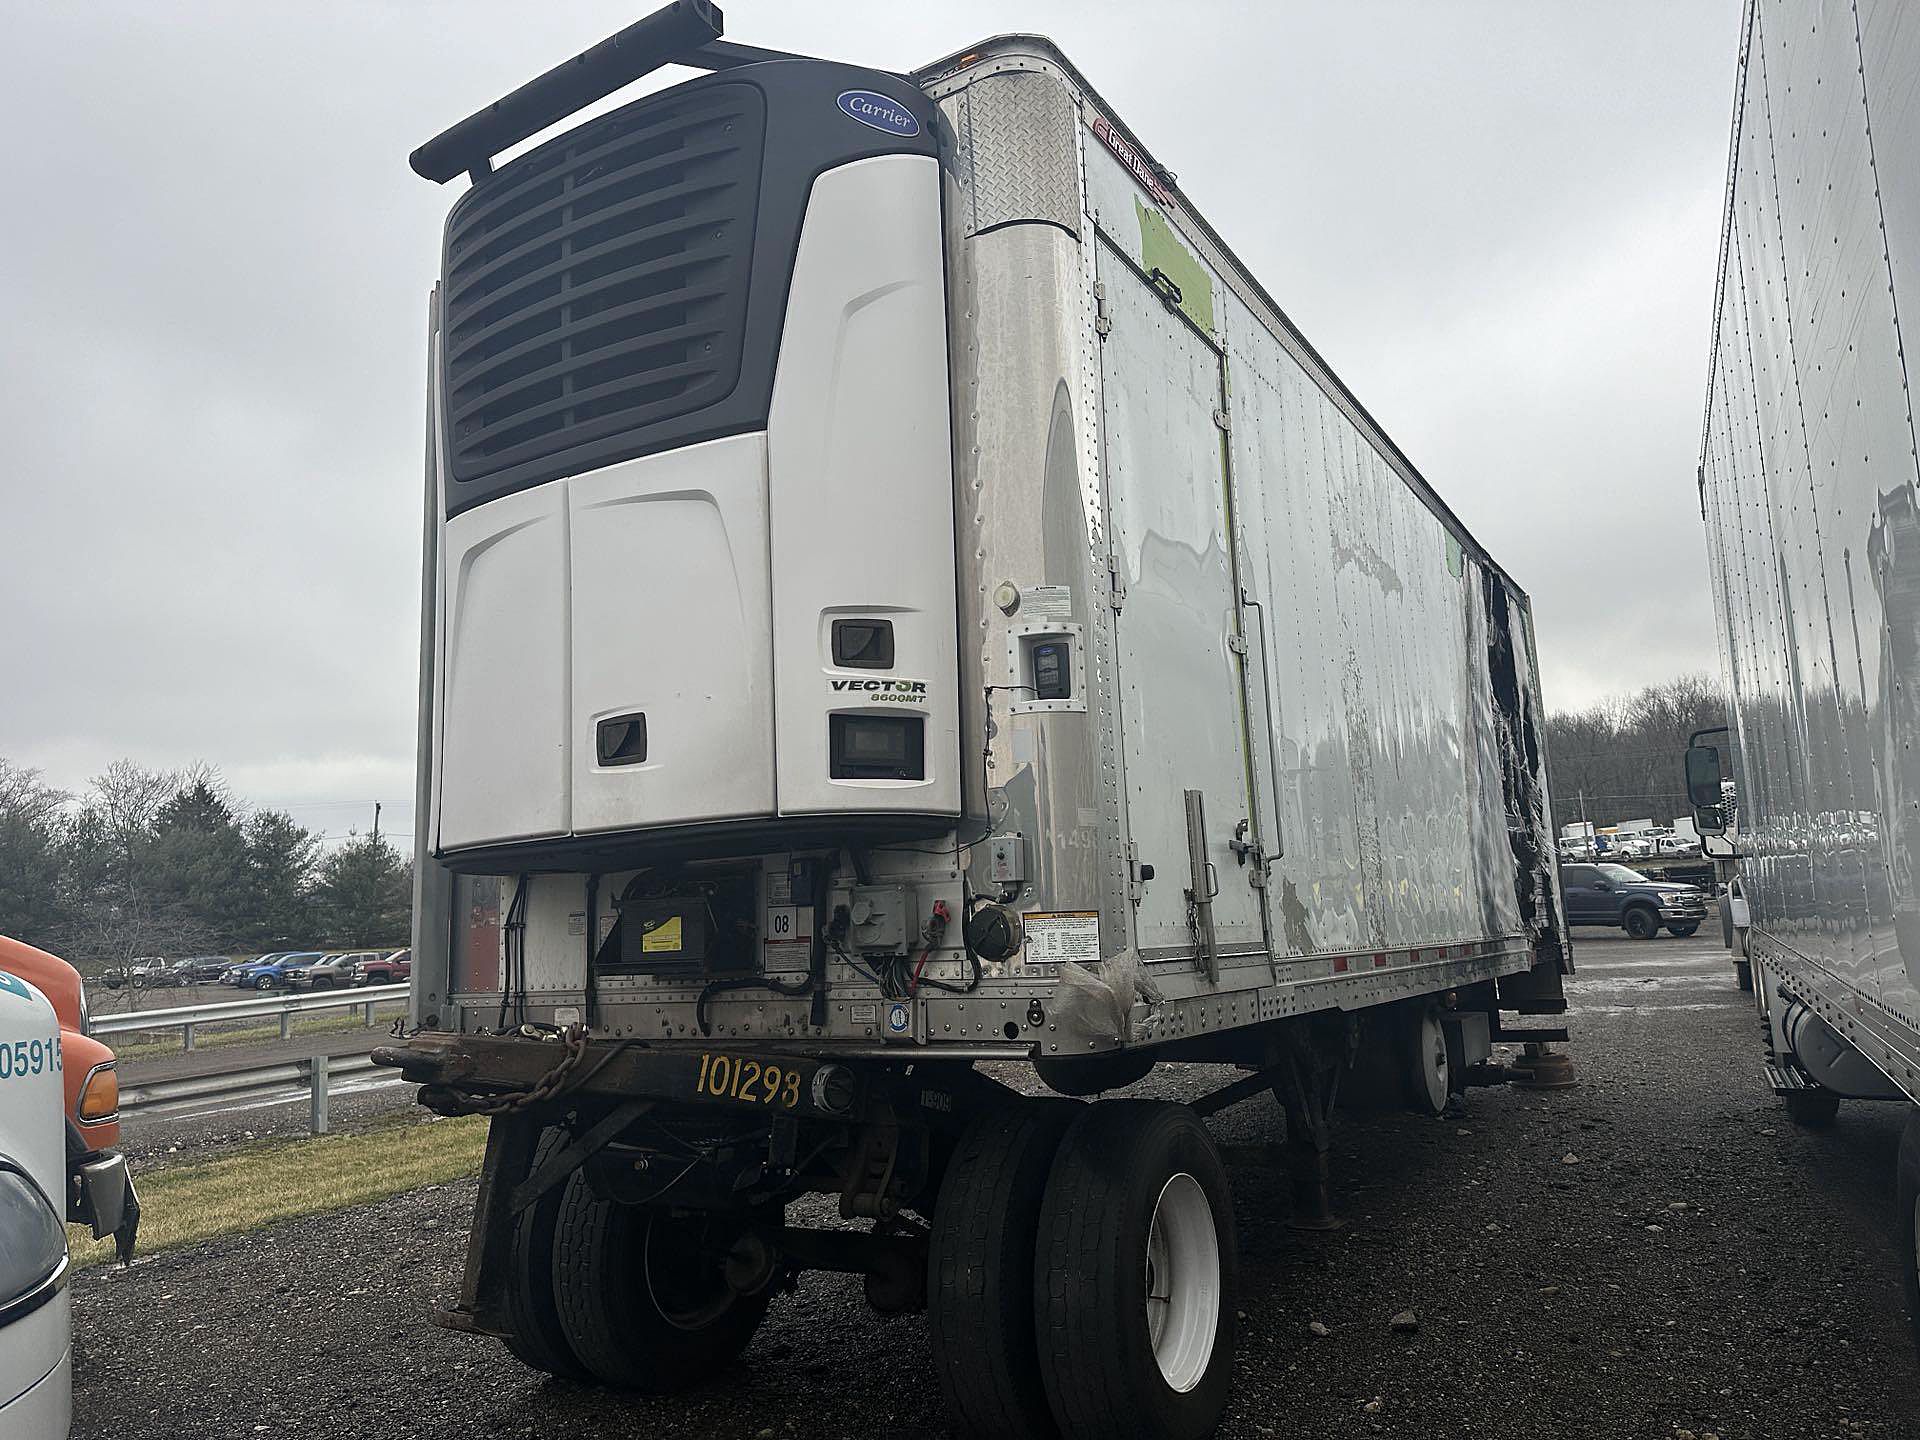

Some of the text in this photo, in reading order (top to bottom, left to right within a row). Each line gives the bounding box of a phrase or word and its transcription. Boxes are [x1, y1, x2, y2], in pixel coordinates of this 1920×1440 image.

[849, 97, 911, 128] Carrier
[1108, 127, 1155, 191] Great Dane
[831, 680, 926, 694] VECTOR
[870, 693, 926, 703] 8600MT
[775, 915, 790, 934] 08
[697, 1052, 800, 1107] 101298
